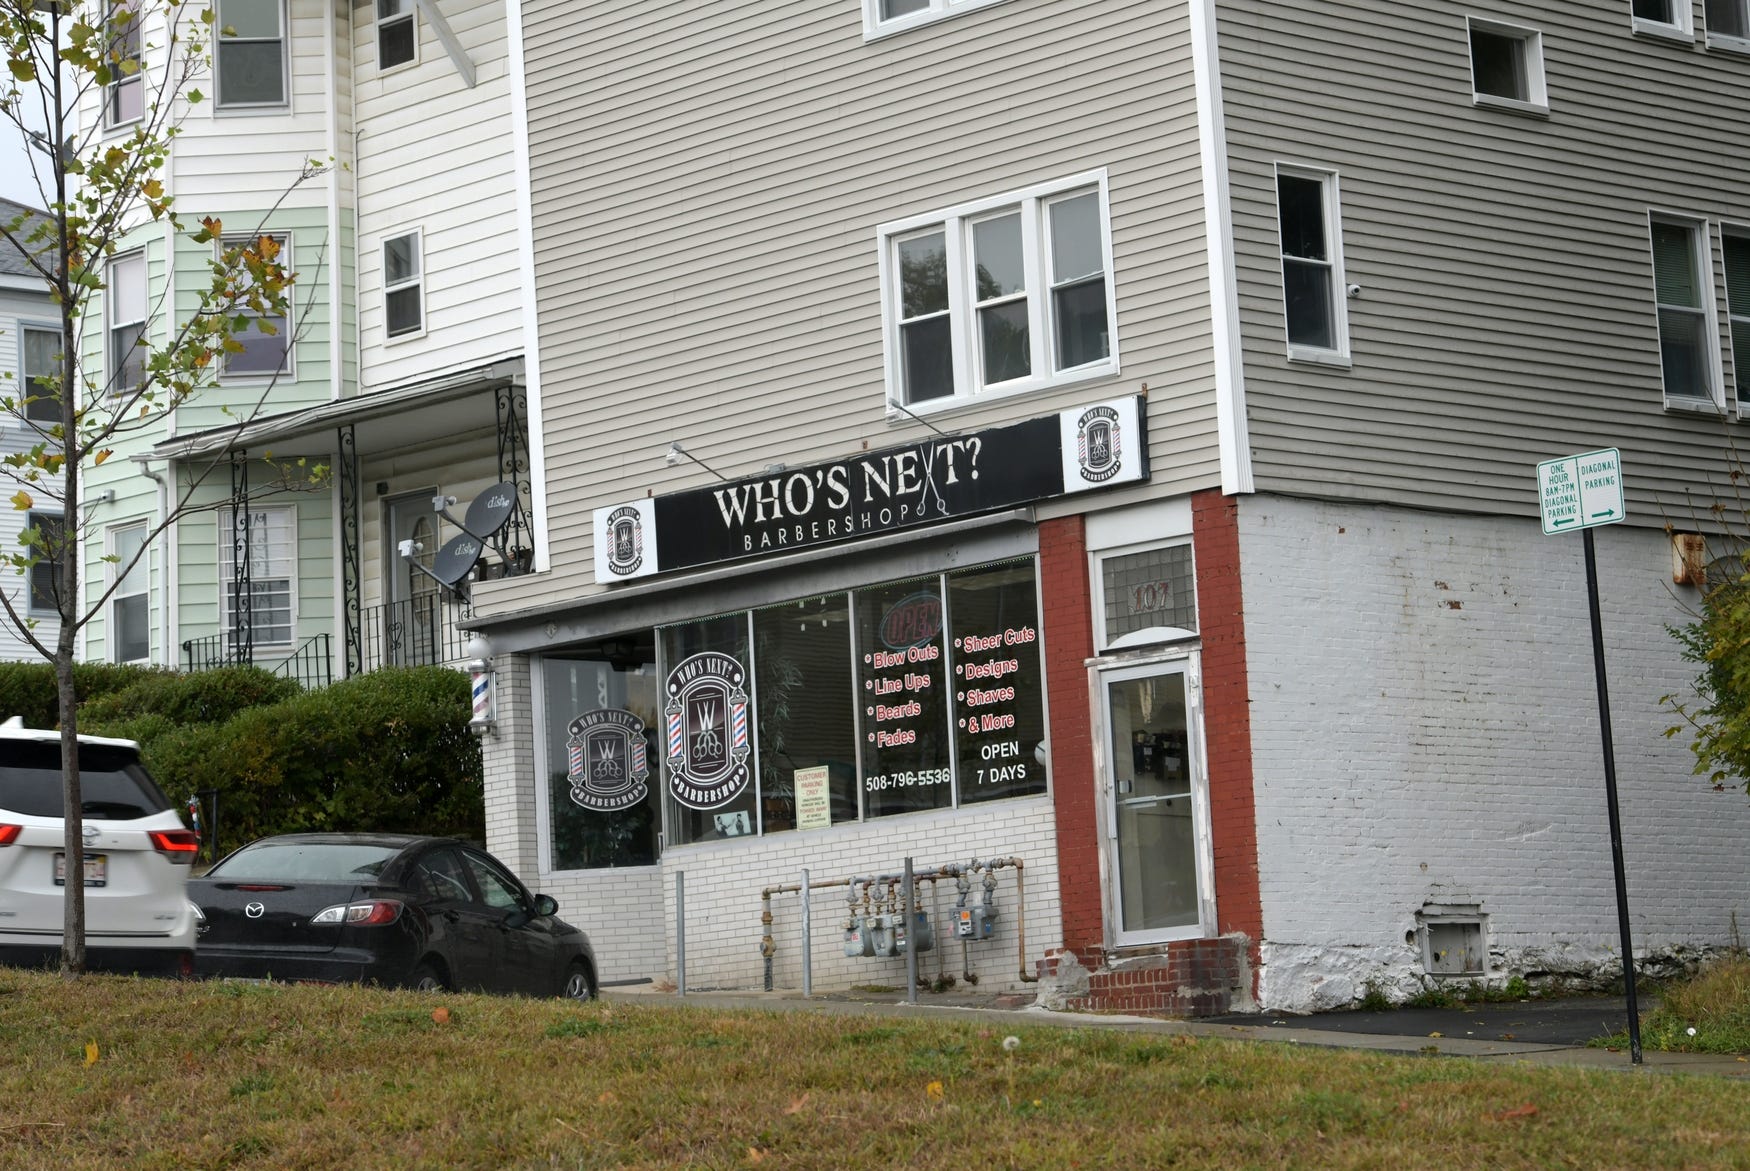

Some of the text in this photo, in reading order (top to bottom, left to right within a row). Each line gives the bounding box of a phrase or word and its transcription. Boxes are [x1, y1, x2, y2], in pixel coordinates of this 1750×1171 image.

[1550, 463, 1565, 475] ONE
[1581, 460, 1616, 475] DIAGONAL
[713, 437, 982, 529] WHO'S NEXT?
[1548, 473, 1569, 485] HOUR
[1584, 475, 1615, 490] PARKING
[1545, 483, 1575, 497] 8AM-7PM
[1544, 494, 1578, 508] DIAGONAL
[1548, 504, 1577, 518] PARKING
[744, 503, 909, 551] BARBERSHOP
[1135, 580, 1170, 613] 107
[886, 600, 942, 645] OPEN
[963, 626, 1035, 653] Sheer Cuts
[873, 643, 938, 669] Blow Outs
[676, 657, 734, 685] WHO'S NEXT?
[965, 659, 1018, 680] Designs
[875, 673, 930, 695] Line Ups
[966, 686, 1015, 706] Shaves
[579, 711, 634, 729] WHO'S NEXT?
[876, 700, 921, 721] Beards
[968, 713, 1015, 734] & More
[877, 729, 916, 748] Fades
[981, 741, 1019, 760] OPEN
[866, 768, 950, 792] 508-796-5536
[977, 764, 1026, 784] 7 DAYS
[577, 789, 640, 807] BARBERSHOP
[676, 775, 741, 803] BARBERSHOP
